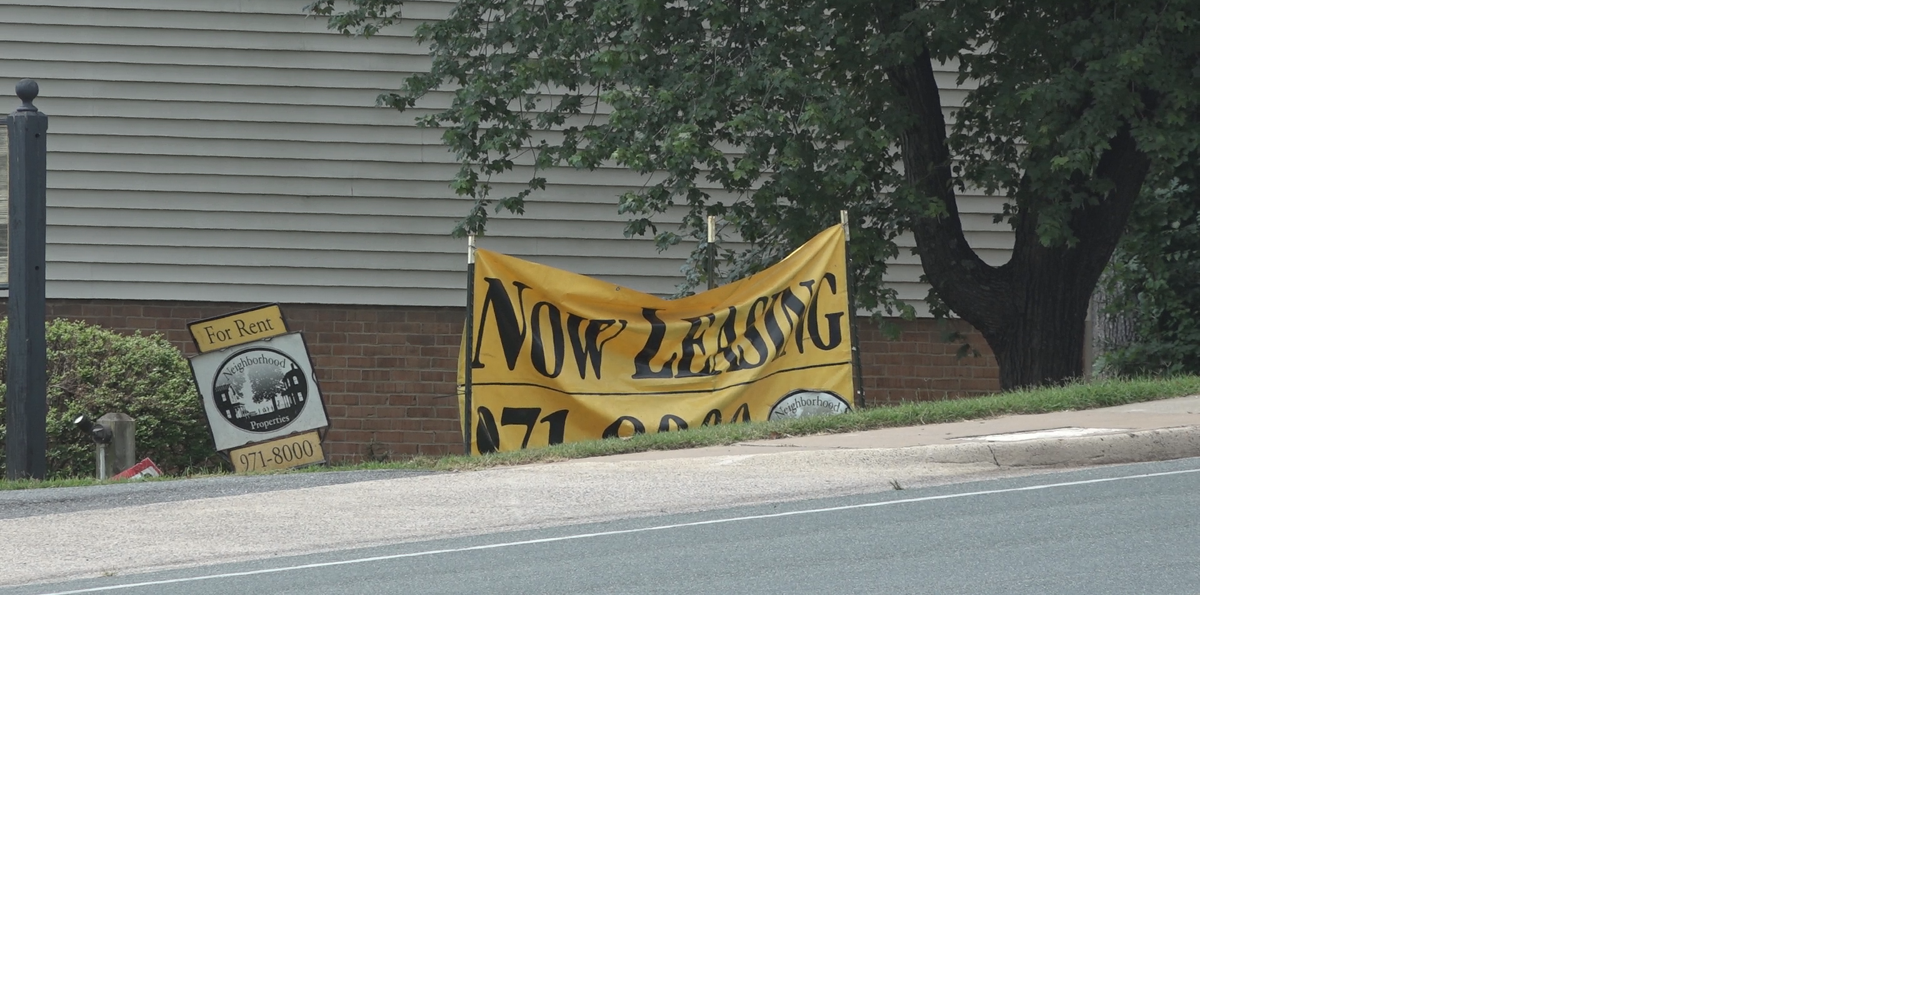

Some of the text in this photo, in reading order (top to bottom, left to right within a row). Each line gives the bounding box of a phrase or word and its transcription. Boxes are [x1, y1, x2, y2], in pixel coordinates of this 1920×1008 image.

[204, 319, 275, 345] For Rent
[631, 272, 845, 380] LEASING
[223, 354, 286, 380] Neighborhood
[774, 396, 841, 419] Neighborhood
[250, 415, 290, 430] Properties
[240, 440, 314, 471] 971-8000
